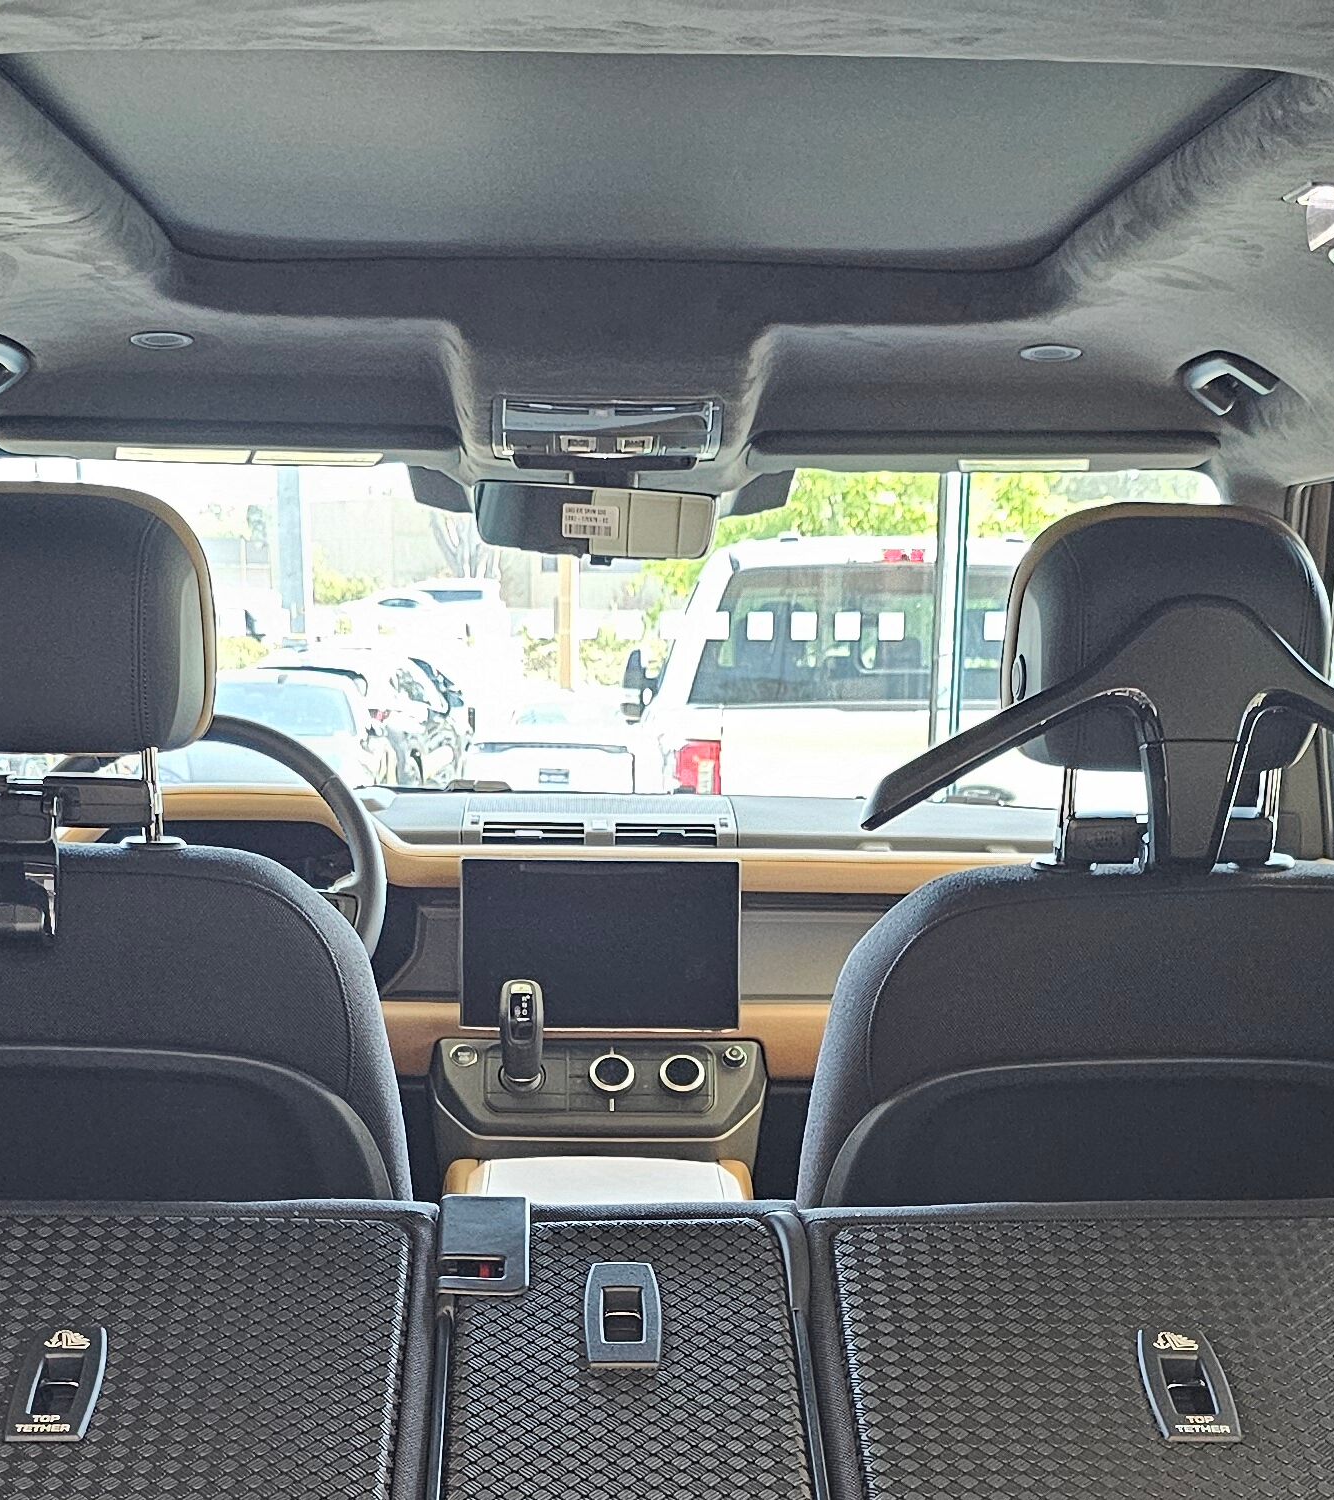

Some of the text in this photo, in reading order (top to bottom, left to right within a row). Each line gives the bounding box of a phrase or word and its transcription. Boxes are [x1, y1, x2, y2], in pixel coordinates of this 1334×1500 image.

[32, 1414, 61, 1423] TOP
[1185, 1415, 1215, 1424] TOP
[15, 1423, 71, 1433] TETHER
[1174, 1424, 1231, 1434] TETHER
